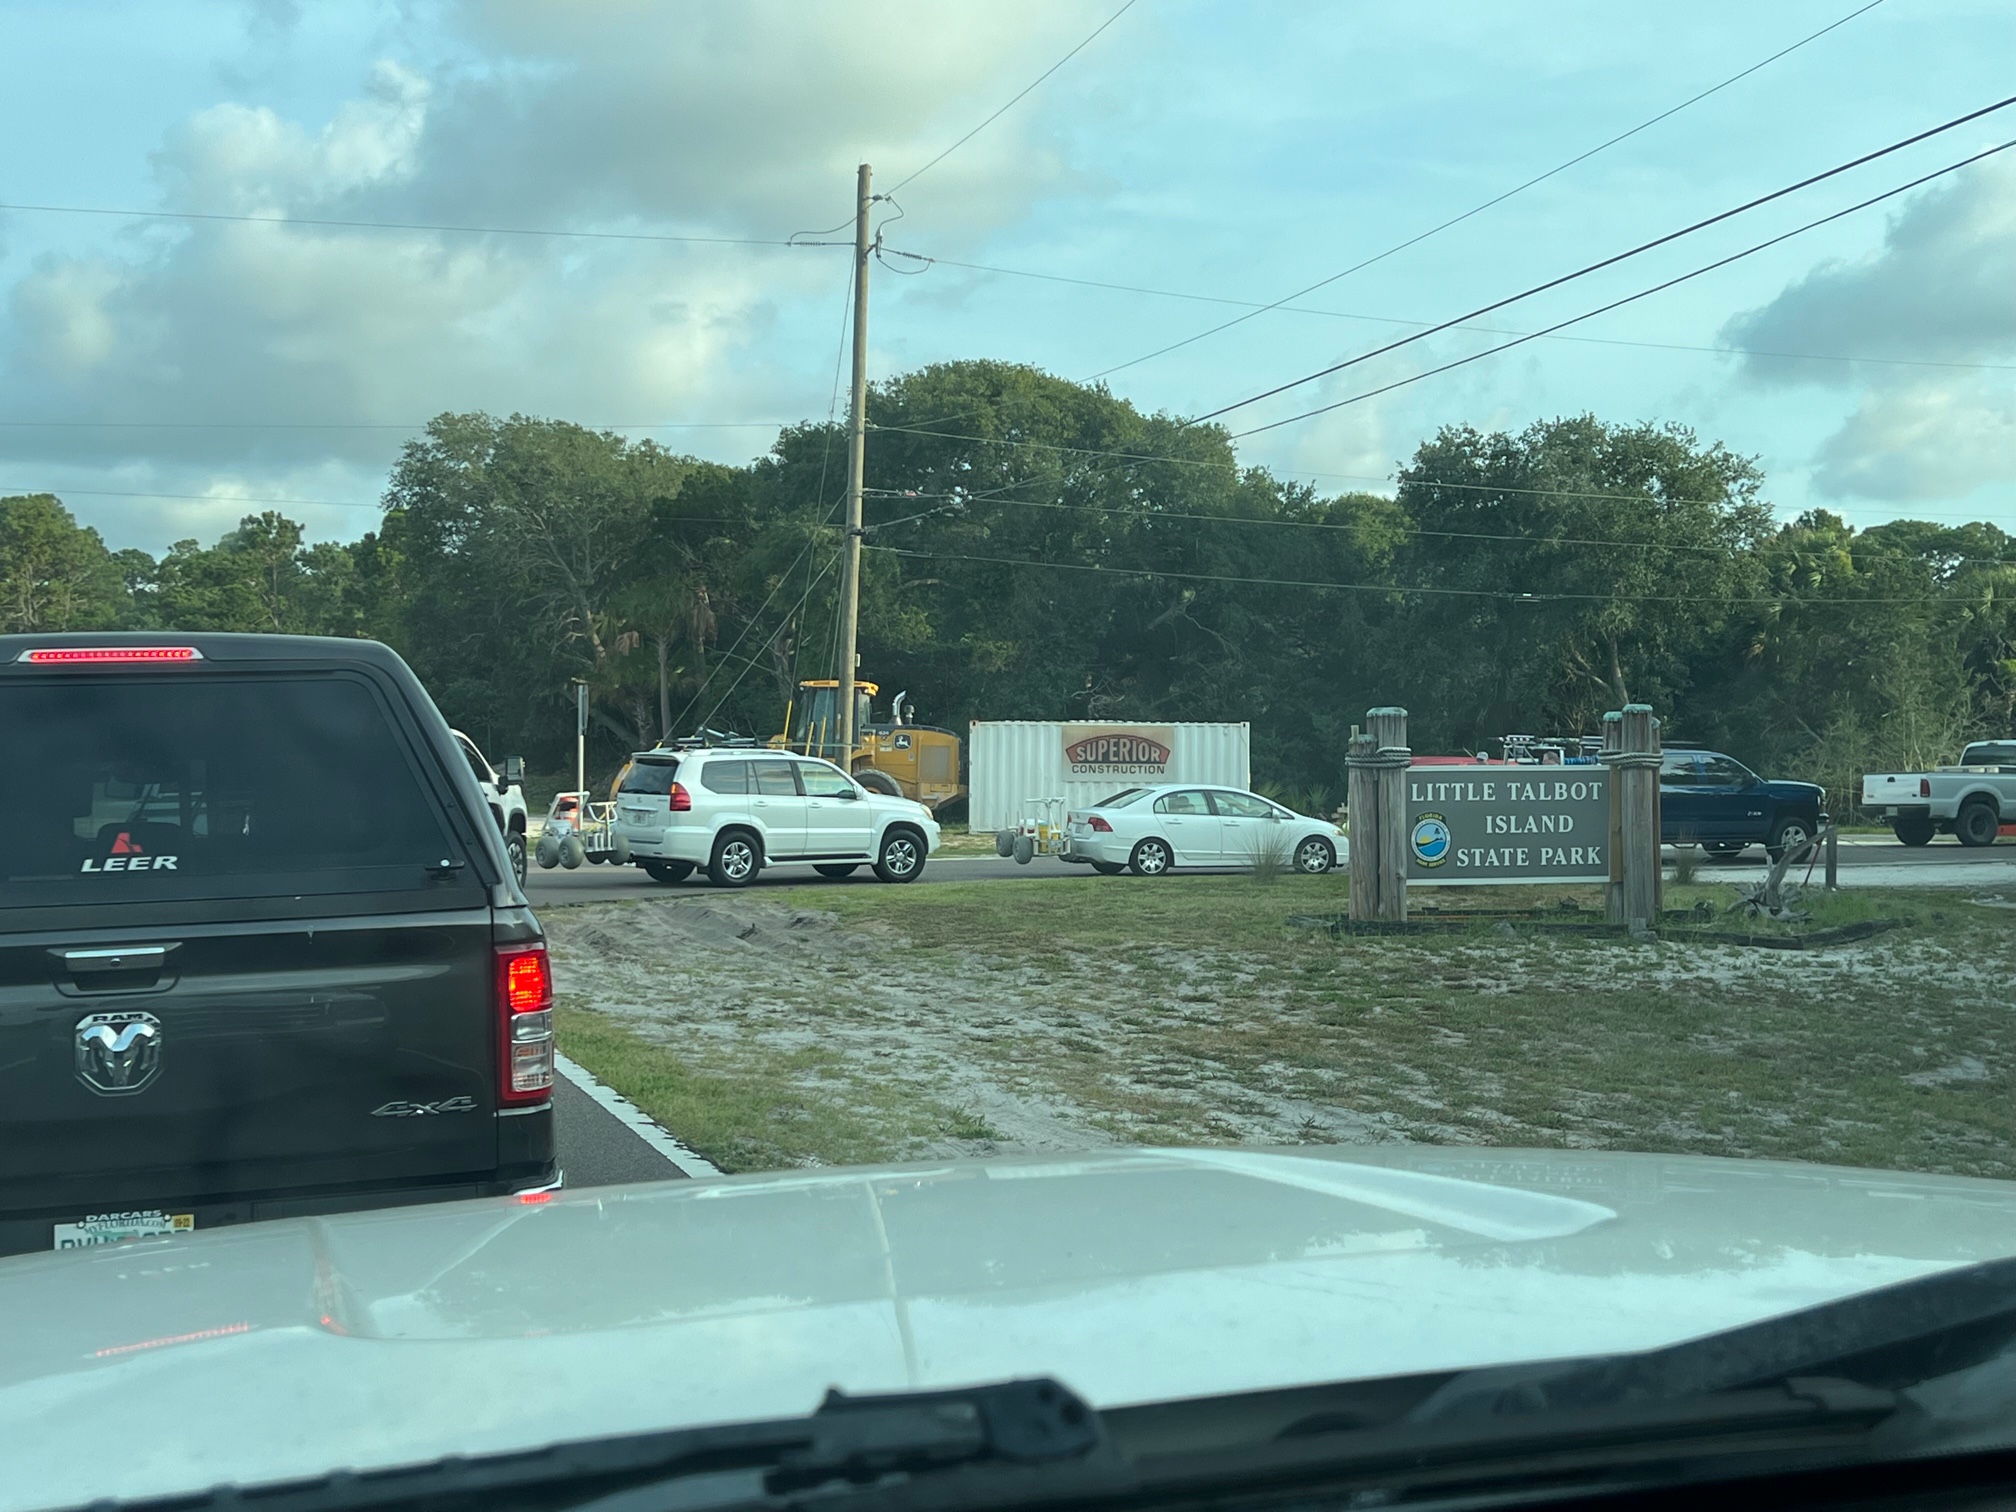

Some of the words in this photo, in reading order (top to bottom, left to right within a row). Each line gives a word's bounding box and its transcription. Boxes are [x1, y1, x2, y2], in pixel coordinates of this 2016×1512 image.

[1076, 738, 1160, 762] SUPERIOR
[1071, 764, 1165, 775] CONSTRUCTION
[1411, 782, 1497, 802] LITTLE
[1507, 781, 1603, 801] TALBOT
[1485, 814, 1574, 834] ISLAND
[80, 855, 178, 873] LEER
[1456, 848, 1529, 868] STATE
[1540, 846, 1602, 866] PARK
[92, 1013, 144, 1023] RAM
[85, 1209, 162, 1223] DARCARS
